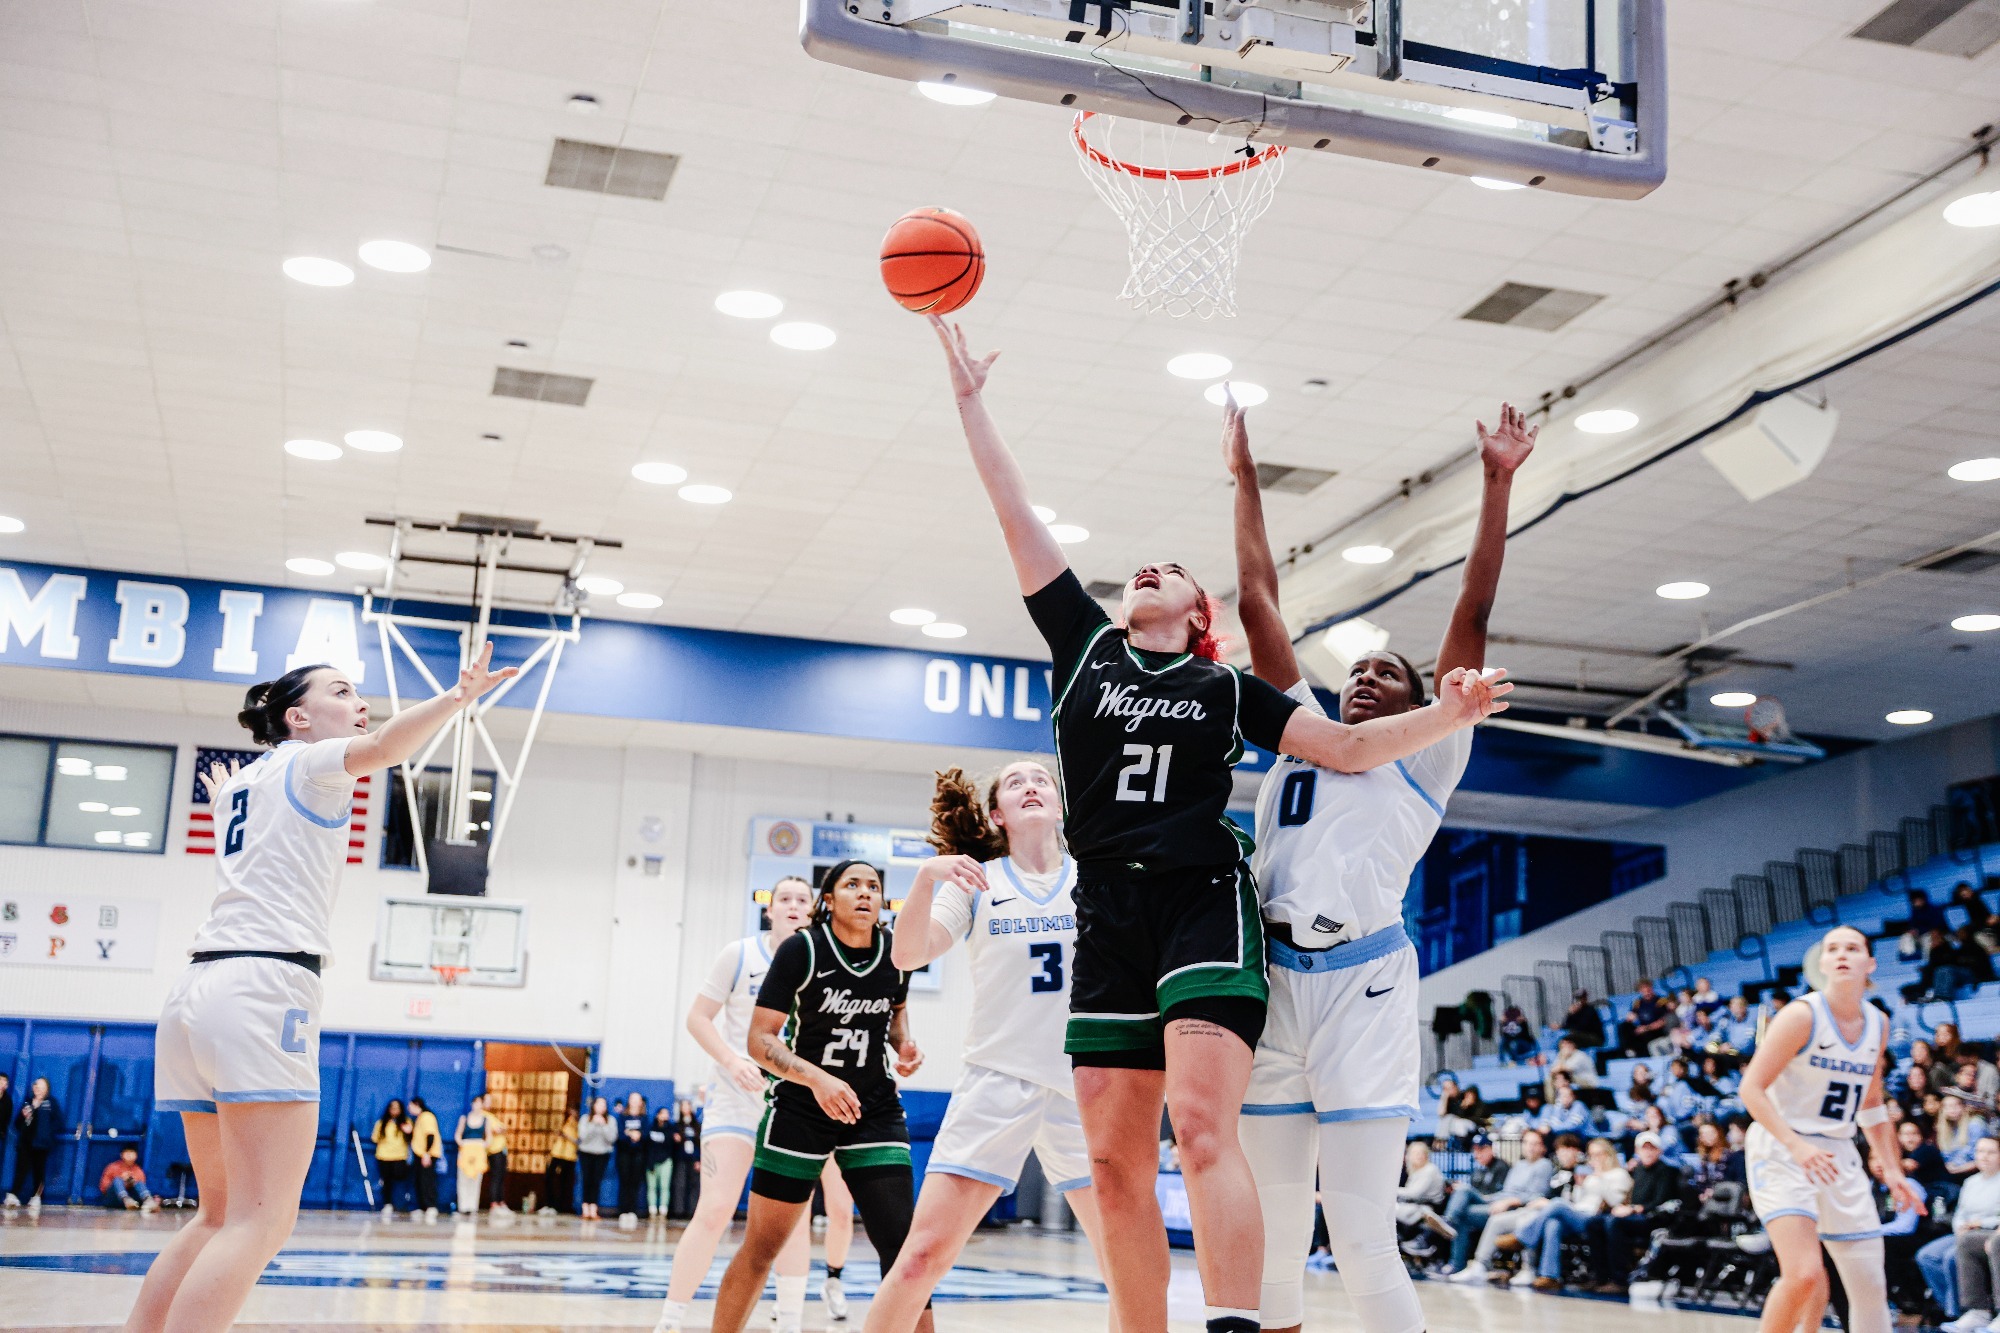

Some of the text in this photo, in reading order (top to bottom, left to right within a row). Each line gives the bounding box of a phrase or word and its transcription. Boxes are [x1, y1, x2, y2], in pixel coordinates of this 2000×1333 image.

[0, 567, 366, 684] MBIA
[1094, 681, 1207, 733] Wagner
[1115, 743, 1173, 803] 21
[1278, 768, 1318, 829] 0
[223, 788, 249, 858] 2
[95, 938, 117, 960] Y
[989, 914, 1075, 935] COLUMB
[1028, 941, 1064, 994] 3
[280, 1007, 310, 1055] C
[817, 986, 891, 1025] Wagner
[1818, 1080, 1864, 1123] 21
